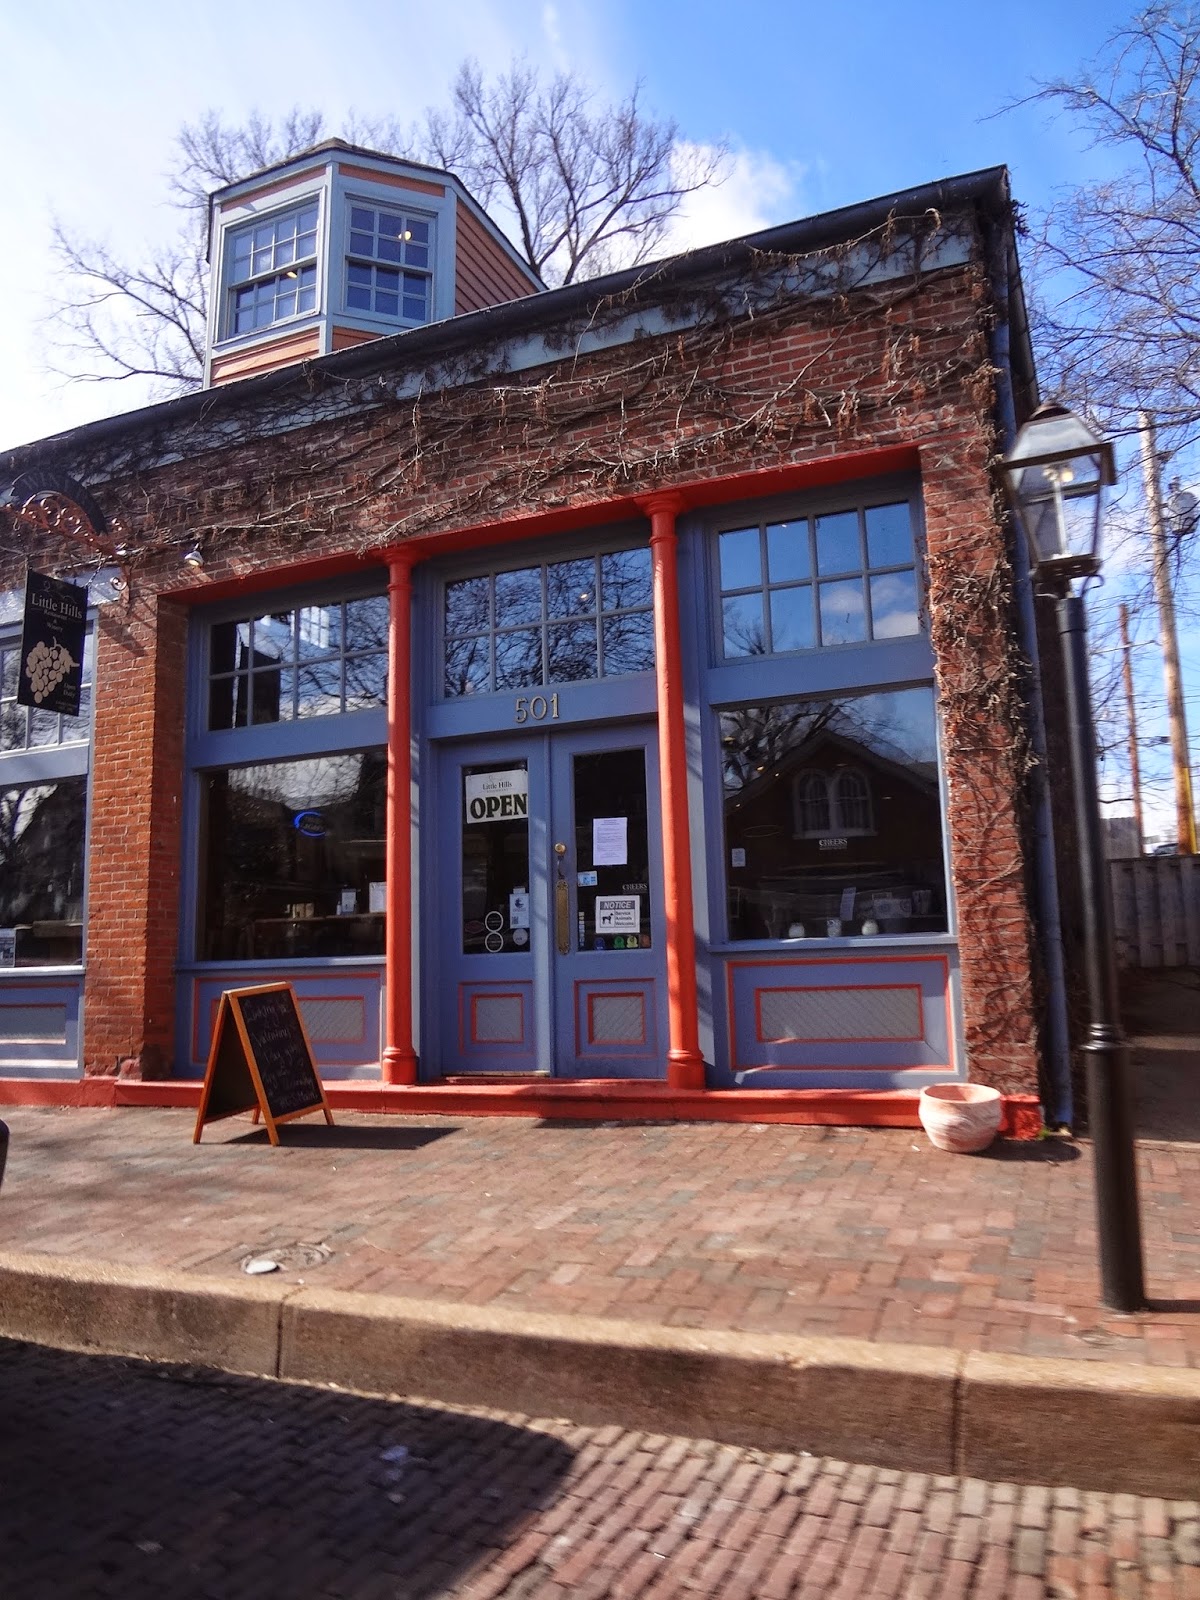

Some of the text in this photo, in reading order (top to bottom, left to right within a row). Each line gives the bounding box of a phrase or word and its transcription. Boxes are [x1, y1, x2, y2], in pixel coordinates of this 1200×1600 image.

[31, 592, 83, 619] Little Hills
[515, 692, 559, 724] 501
[482, 783, 498, 791] Little
[498, 780, 513, 789] Hills
[470, 793, 527, 820] OPEN
[622, 883, 648, 891] CHEERS
[603, 901, 632, 909] NOTICE
